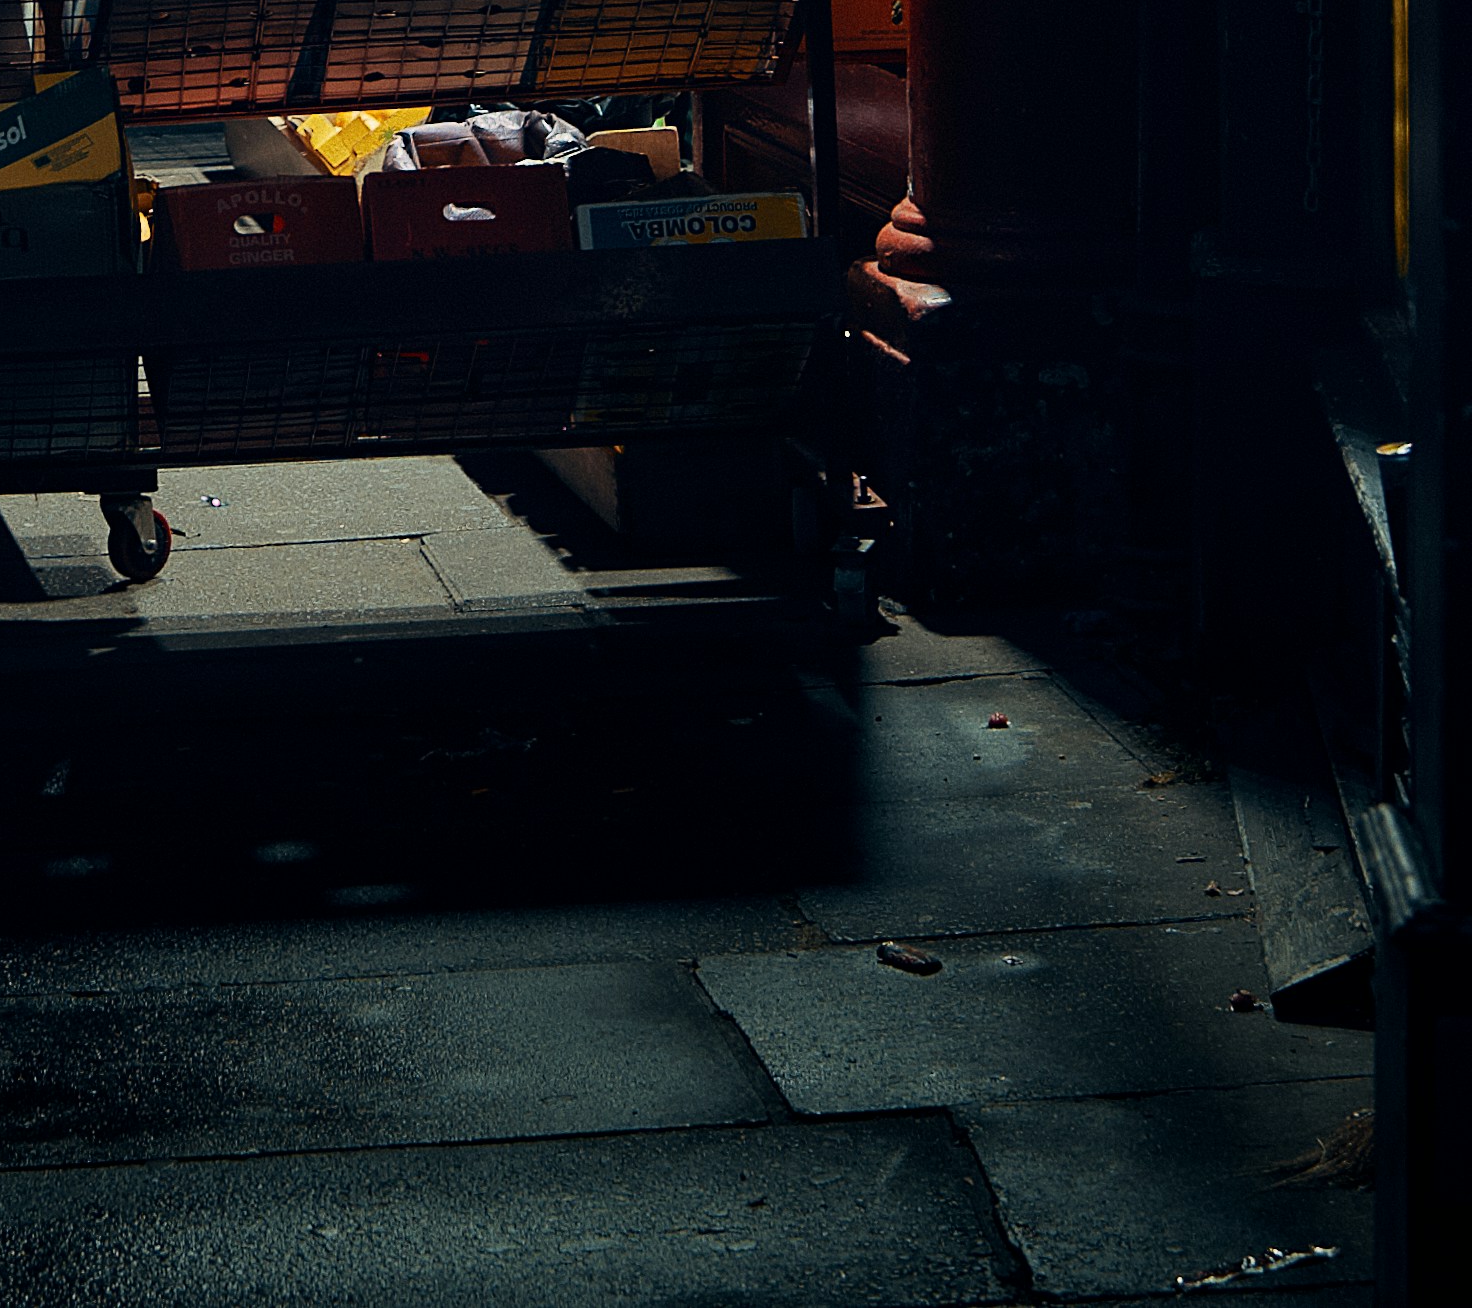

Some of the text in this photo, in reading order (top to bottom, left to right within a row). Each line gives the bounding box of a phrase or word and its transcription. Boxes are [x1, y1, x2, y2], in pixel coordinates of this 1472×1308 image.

[706, 201, 758, 213] PRODUCT
[628, 214, 758, 241] COLOMBA
[228, 232, 292, 249] QUALITY
[228, 248, 296, 265] GINGER
